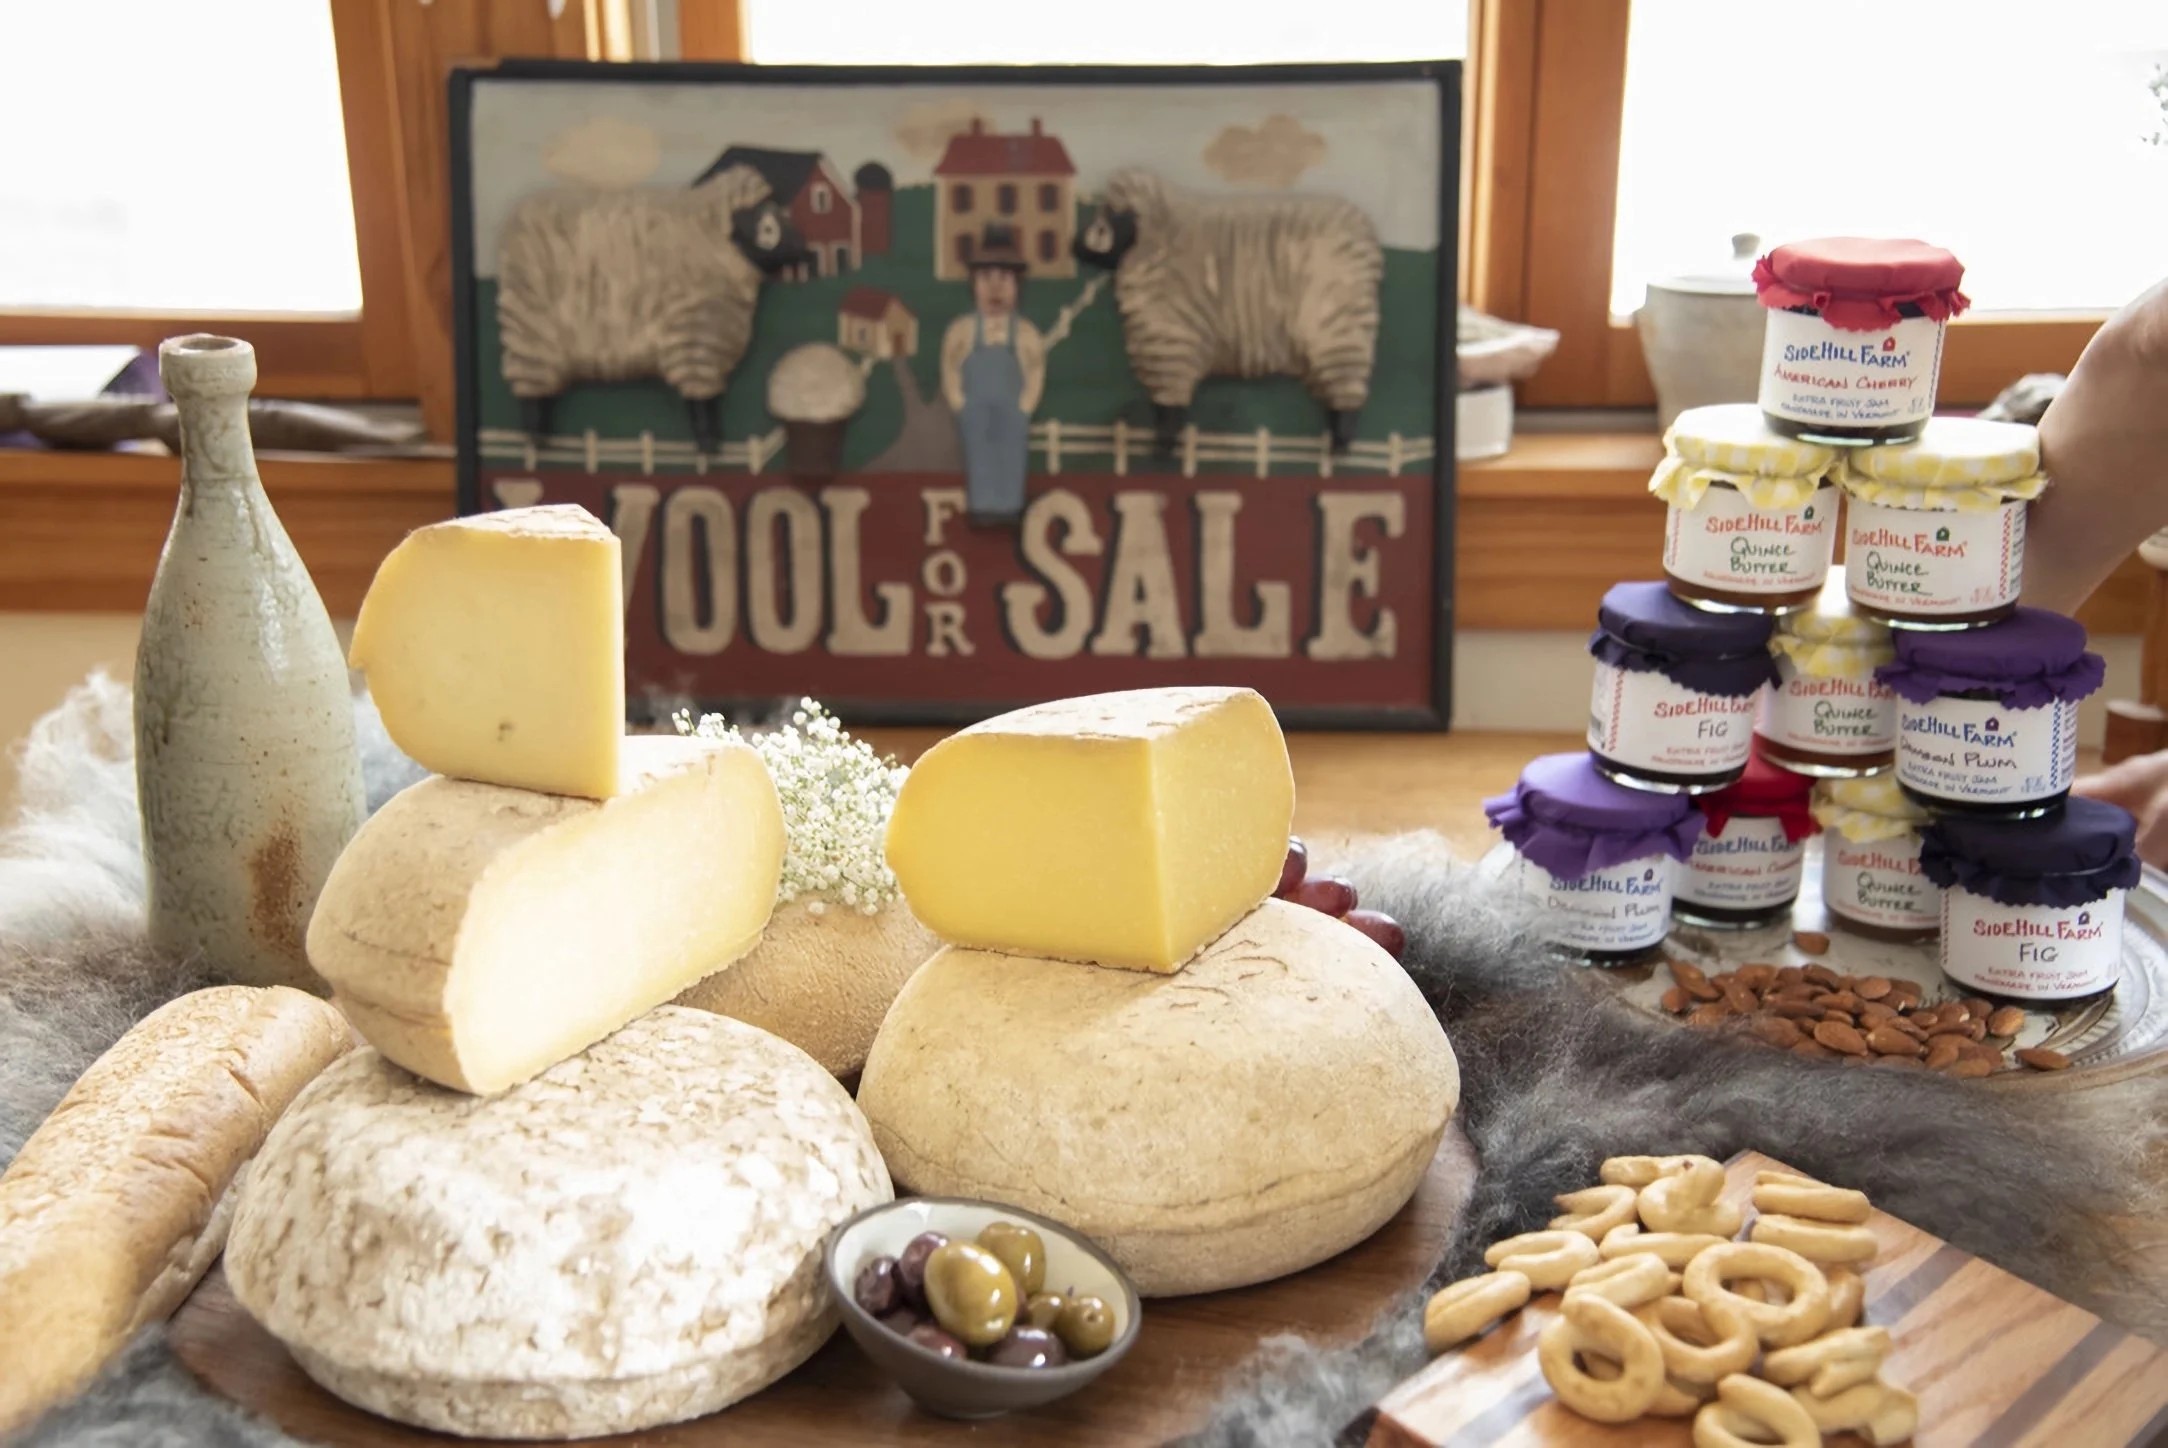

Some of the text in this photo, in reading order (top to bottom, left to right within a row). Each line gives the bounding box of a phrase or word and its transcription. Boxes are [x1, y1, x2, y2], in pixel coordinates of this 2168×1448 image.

[1003, 490, 1406, 660] SALE
[1698, 720, 1728, 739] FIG
[2019, 943, 2059, 963] FIG
